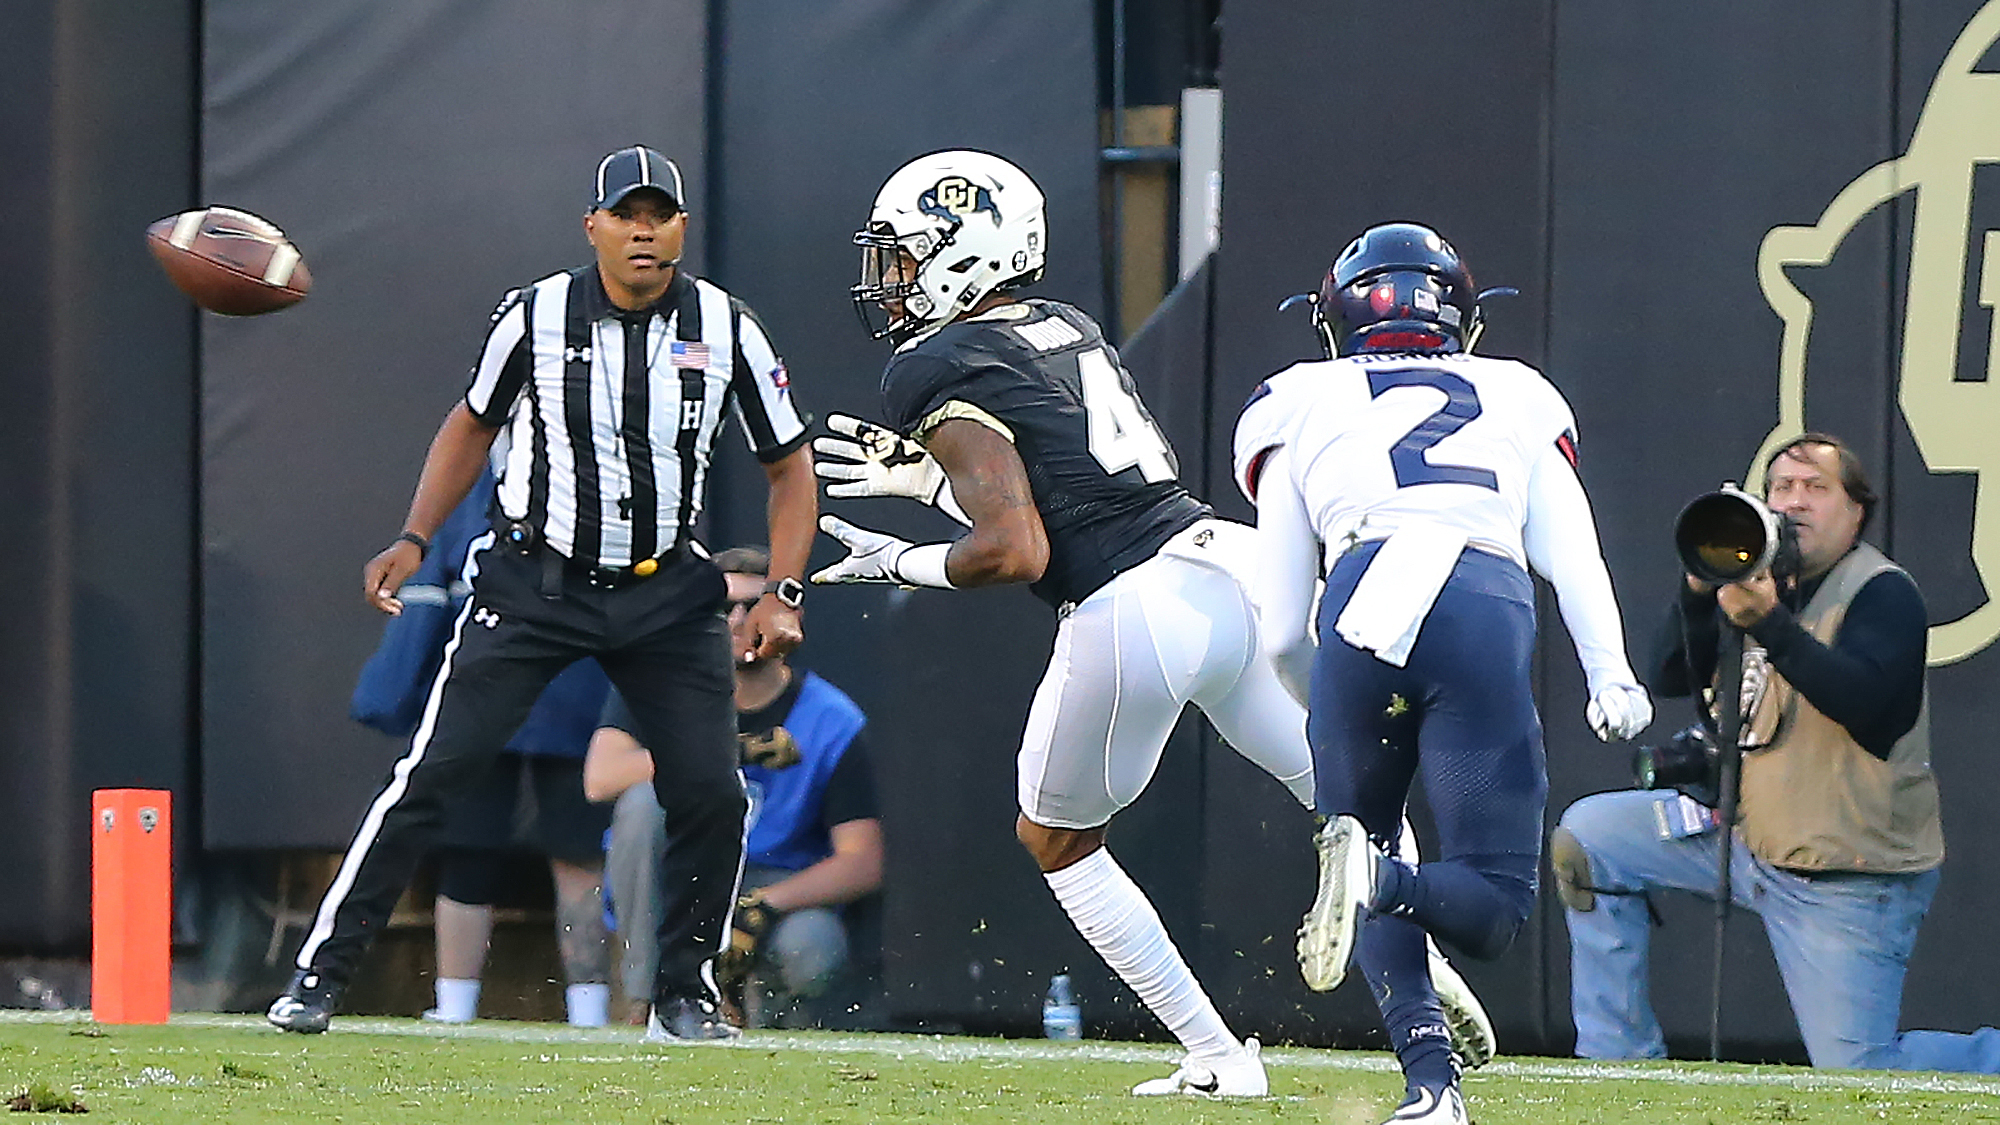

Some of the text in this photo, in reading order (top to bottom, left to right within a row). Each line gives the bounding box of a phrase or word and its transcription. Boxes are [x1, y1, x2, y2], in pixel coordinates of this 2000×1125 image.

[681, 400, 703, 430] H
[1076, 347, 1180, 484] 4
[1365, 367, 1499, 493] 2
